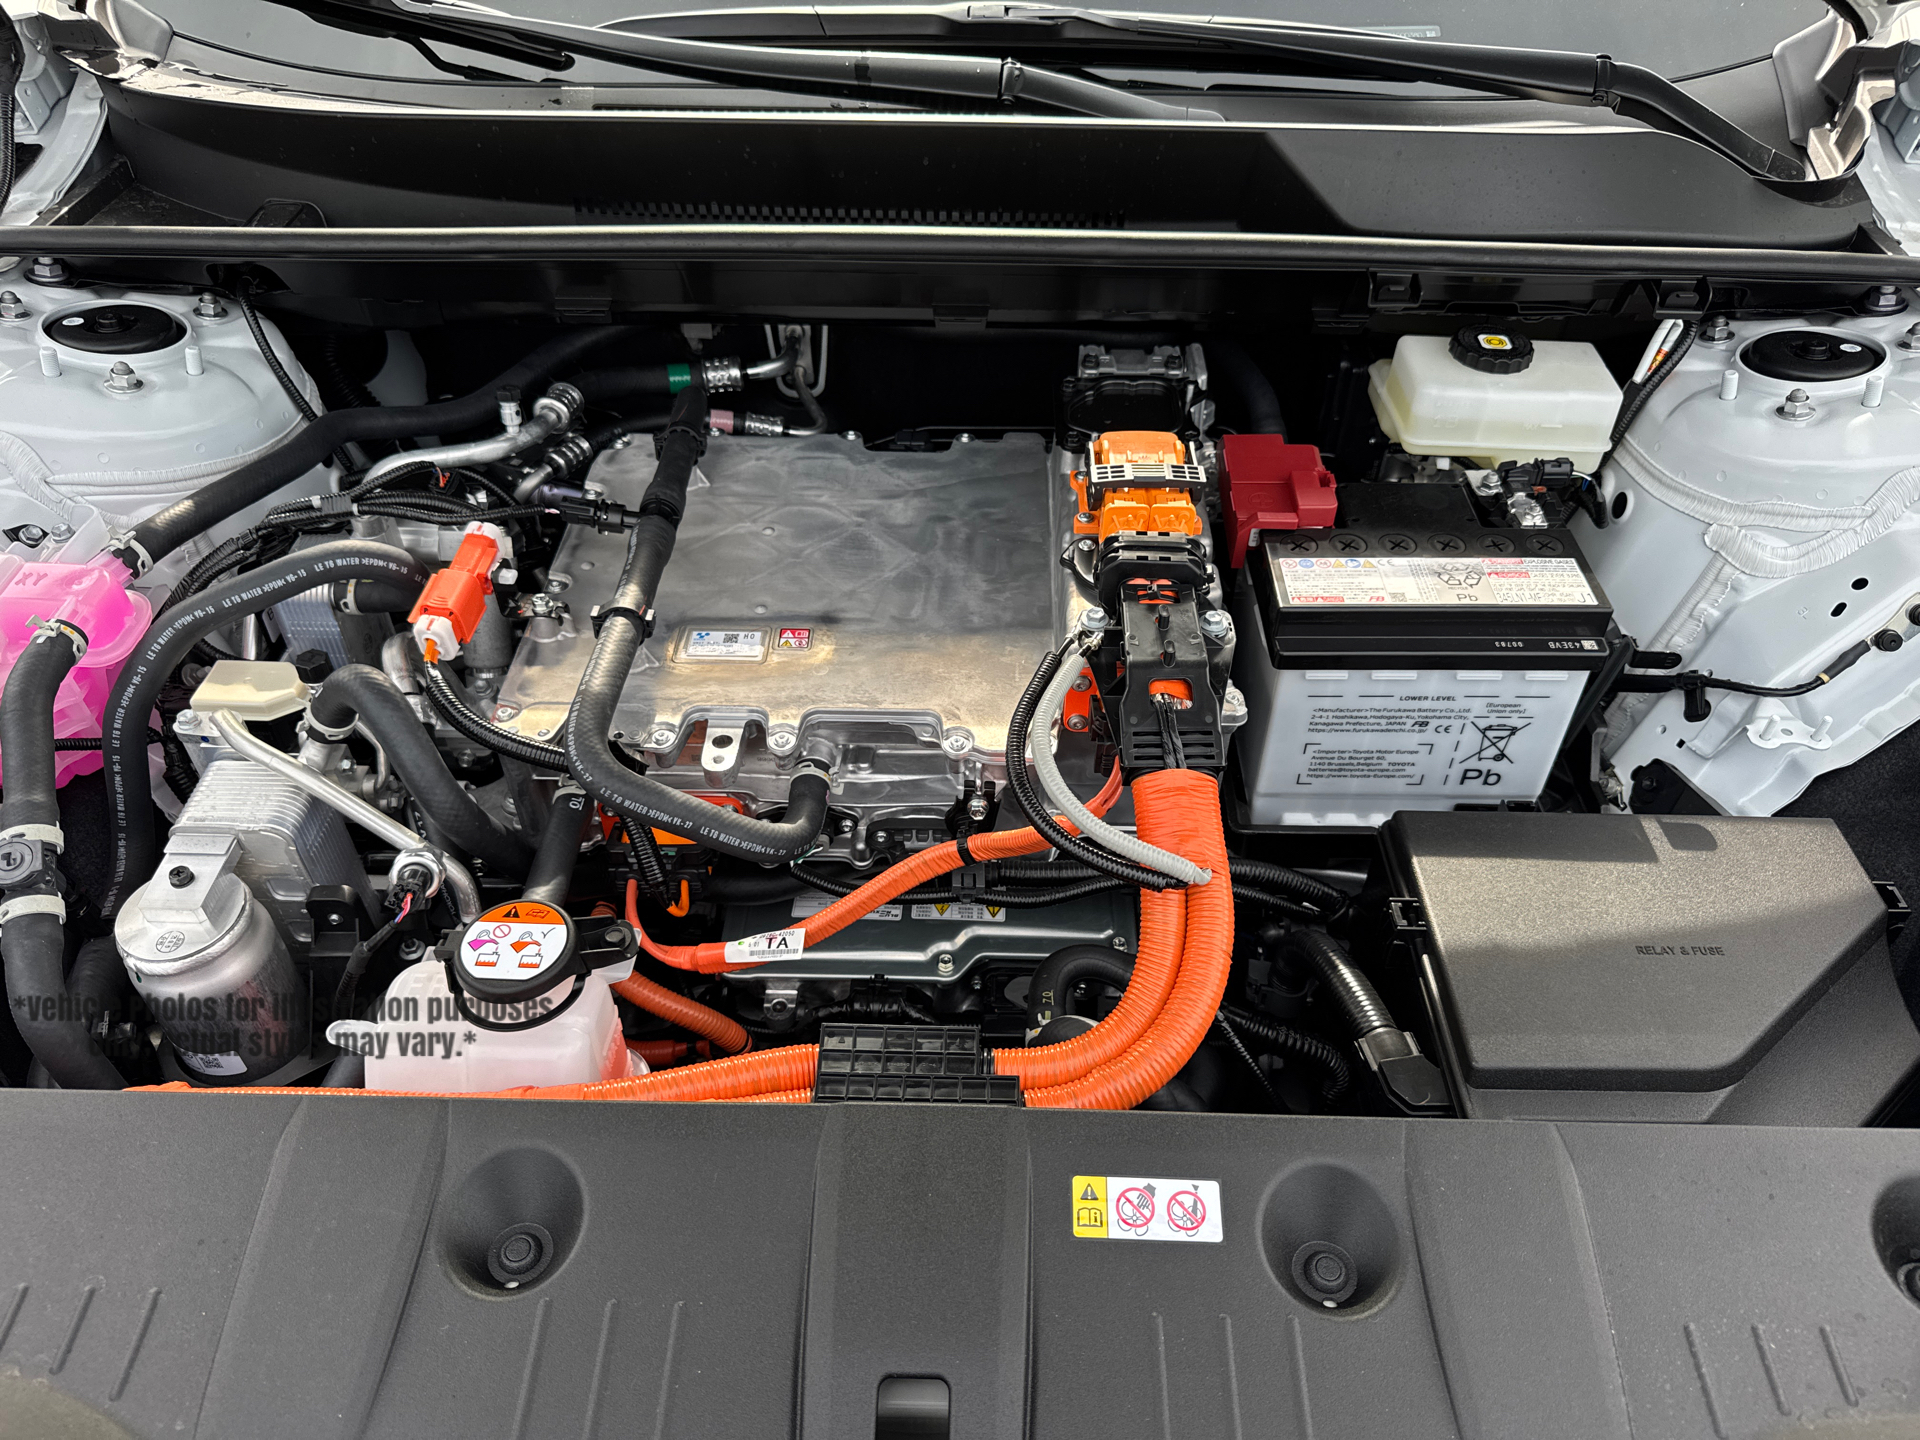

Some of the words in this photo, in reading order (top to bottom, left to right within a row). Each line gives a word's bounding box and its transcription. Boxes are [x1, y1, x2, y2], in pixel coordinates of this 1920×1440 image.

[1459, 768, 1502, 786] Pb
[765, 936, 789, 949] TA
[1635, 946, 1676, 956] RELAY
[1680, 946, 1690, 956] &
[1690, 946, 1726, 956] FUSE
